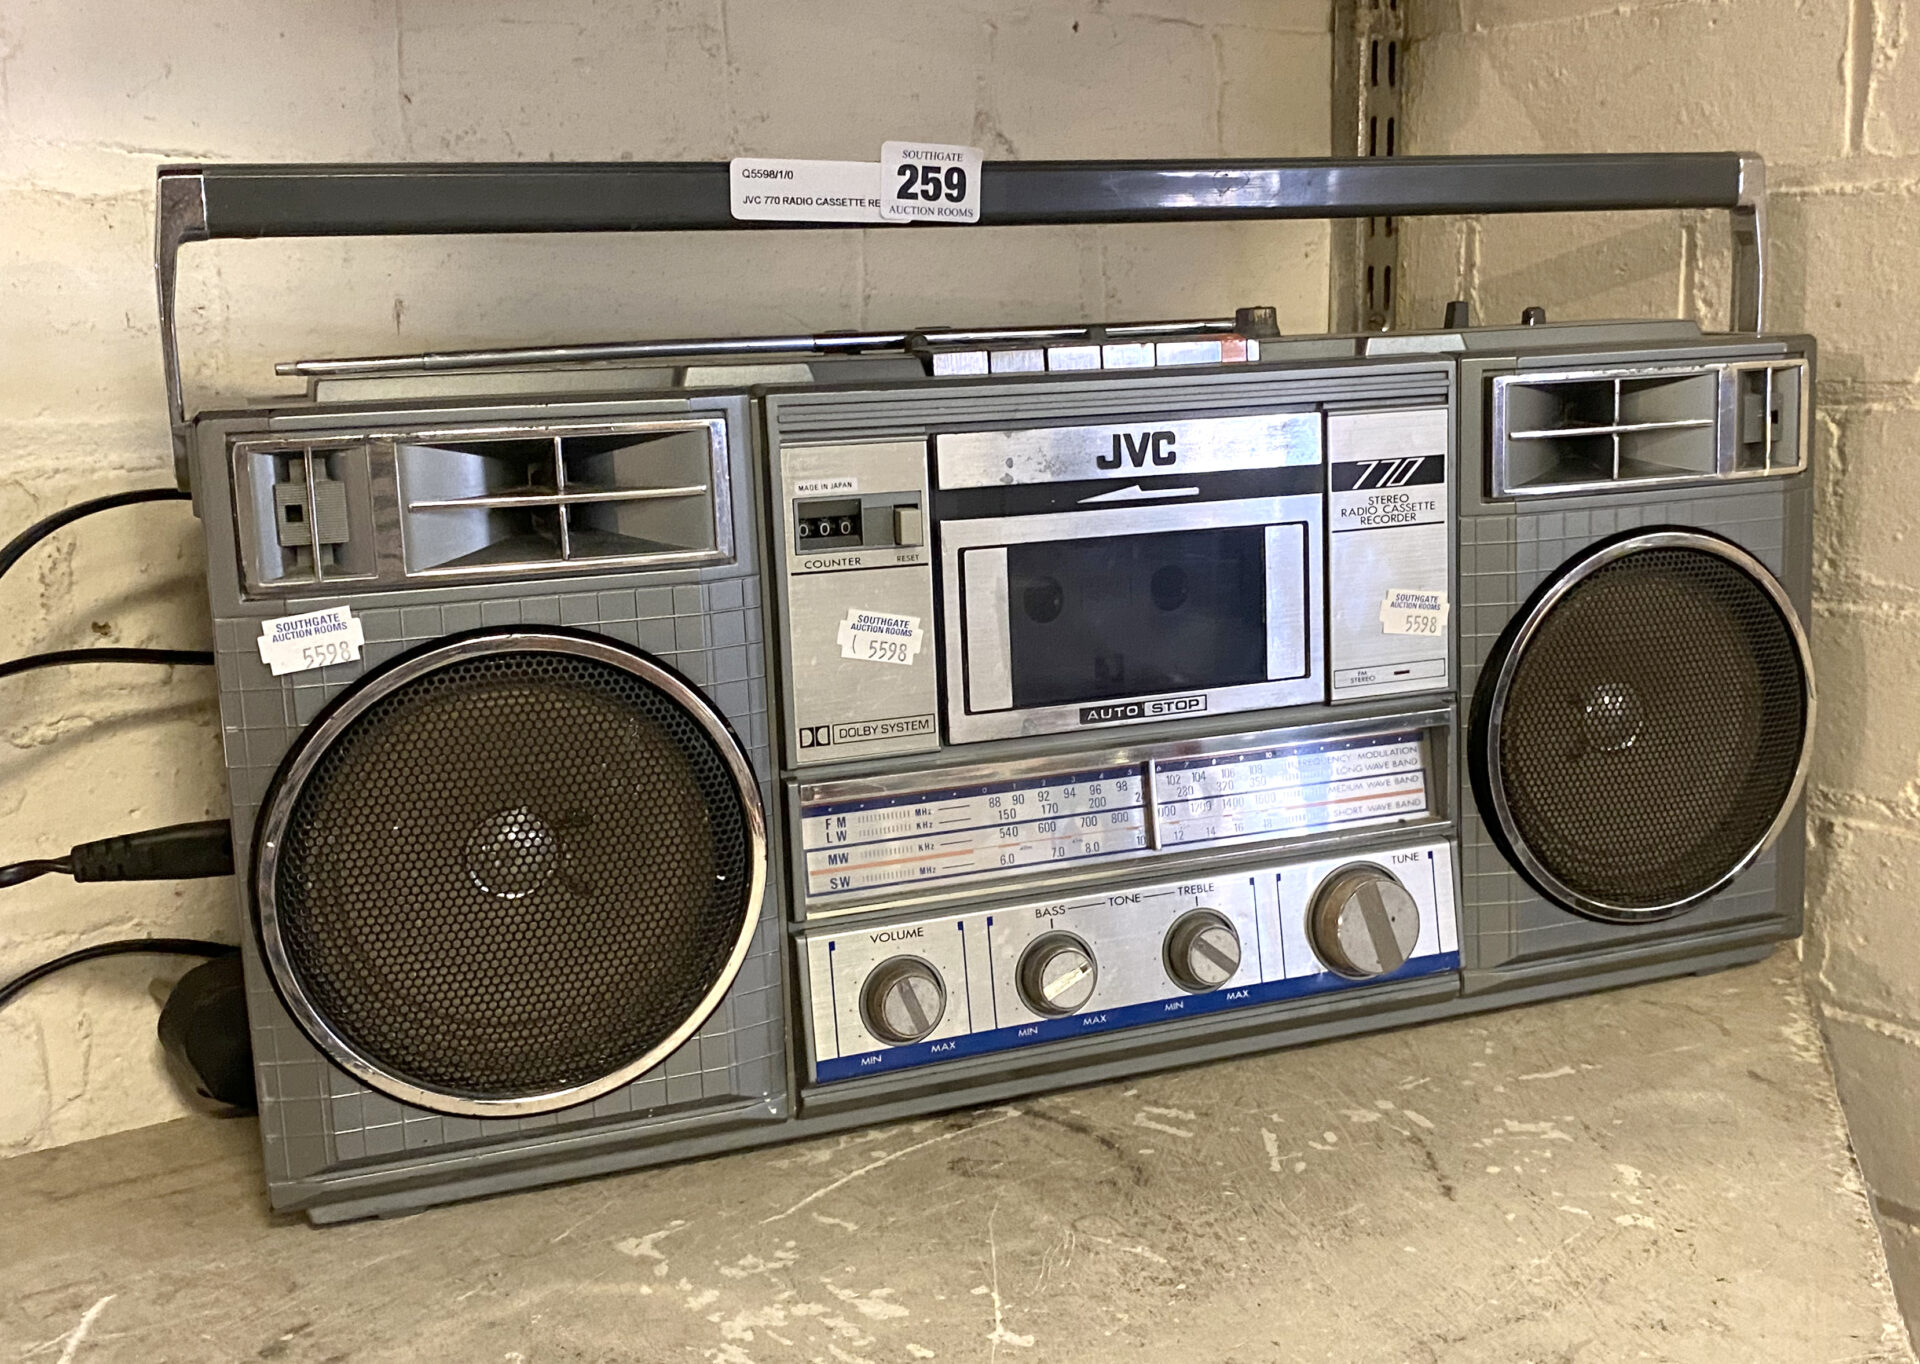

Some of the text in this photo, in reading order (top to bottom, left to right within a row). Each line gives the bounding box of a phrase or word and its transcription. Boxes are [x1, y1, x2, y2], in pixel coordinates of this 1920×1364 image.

[902, 150, 963, 162] SOUTHGATE
[742, 168, 794, 180] Q5598/1/0
[897, 164, 967, 202] 259
[742, 196, 881, 208] JVC 770 RADIO CASSETTE RE
[889, 205, 974, 218] AUCTION ROOMS
[1096, 431, 1177, 470] JVC
[1352, 457, 1426, 490] 770
[798, 484, 818, 492] MADE
[830, 482, 852, 490] JAPAN
[1368, 493, 1410, 506] STEREO
[1341, 501, 1436, 518] RADIO CASSETTE
[1360, 512, 1417, 526] RECORDER
[804, 554, 919, 569] COUNTER RESET
[1390, 601, 1441, 611] AUCTION ROOMS
[1395, 593, 1439, 604] SOUTHGATE
[275, 613, 340, 633] SOUTHGATE
[850, 623, 913, 637] AUCTION ROOMS
[857, 614, 910, 629] SOUTHGATE
[1405, 615, 1438, 633] 5598
[272, 621, 348, 643] AUCTION ROOMS
[302, 641, 352, 669] 5598
[868, 640, 908, 662] 5598
[1350, 675, 1376, 684] STEREO
[1087, 699, 1200, 720] AUTO STOP
[839, 719, 929, 739] DOLBY SYSTEM
[825, 816, 847, 831] FM
[914, 807, 932, 816] MHz
[988, 797, 1001, 808] 88
[1012, 793, 1025, 805] 90
[1037, 790, 1050, 802] 92
[1063, 787, 1076, 799] 94
[1089, 784, 1102, 796] 96
[1166, 774, 1181, 786] 102
[1191, 770, 1206, 784] 104
[1358, 746, 1418, 760] MODULATION
[826, 830, 847, 844] LW
[999, 808, 1017, 821] 150
[1041, 803, 1059, 815] 170
[1088, 796, 1107, 809] 200
[1216, 780, 1234, 793] 320
[1336, 765, 1363, 776] LONG
[1365, 760, 1389, 771] WAVE
[1392, 757, 1418, 768] BAND
[828, 852, 849, 866] MW
[999, 826, 1019, 839] 540
[1038, 821, 1057, 833] 600
[1080, 815, 1098, 828] 700
[1111, 811, 1129, 824] 800
[1328, 783, 1364, 794] MEDIUM
[1366, 778, 1391, 789] WAVE
[1394, 775, 1419, 785] BAND
[829, 876, 851, 890] SW
[919, 866, 936, 875] MHz
[1000, 853, 1015, 866] 6.0
[1051, 847, 1065, 858] 7.0
[1085, 841, 1100, 853] 8.0
[1174, 831, 1184, 841] 12
[1206, 826, 1216, 837] 14
[1333, 807, 1362, 817] SHORT
[1367, 802, 1392, 812] WAVE
[1395, 798, 1421, 809] BAND
[1391, 851, 1420, 865] TUNE
[1035, 882, 1215, 919] BASS TONE TREBLE
[870, 927, 924, 944] VOLUME
[1164, 989, 1249, 1011] MIN MAX
[1018, 1015, 1107, 1038] MIN MAX
[861, 1041, 956, 1067] MIN MAX
